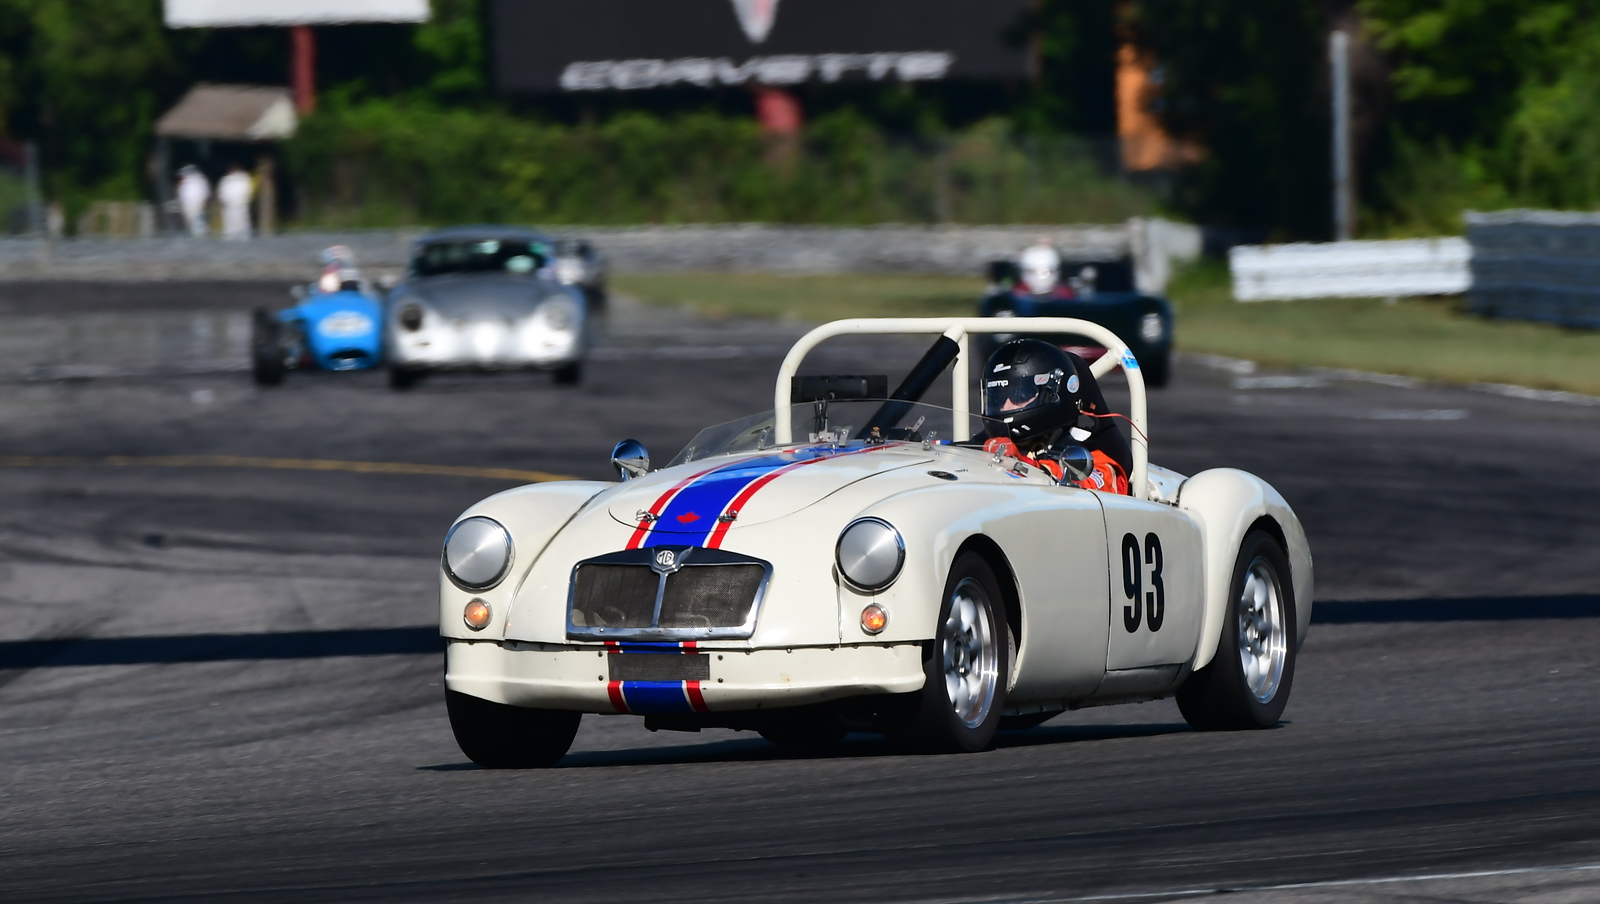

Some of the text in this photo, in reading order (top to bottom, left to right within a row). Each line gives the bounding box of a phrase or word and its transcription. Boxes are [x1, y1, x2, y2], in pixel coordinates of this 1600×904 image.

[560, 52, 951, 90] CORVETTE
[656, 550, 675, 565] MG
[1121, 532, 1165, 633] 93
